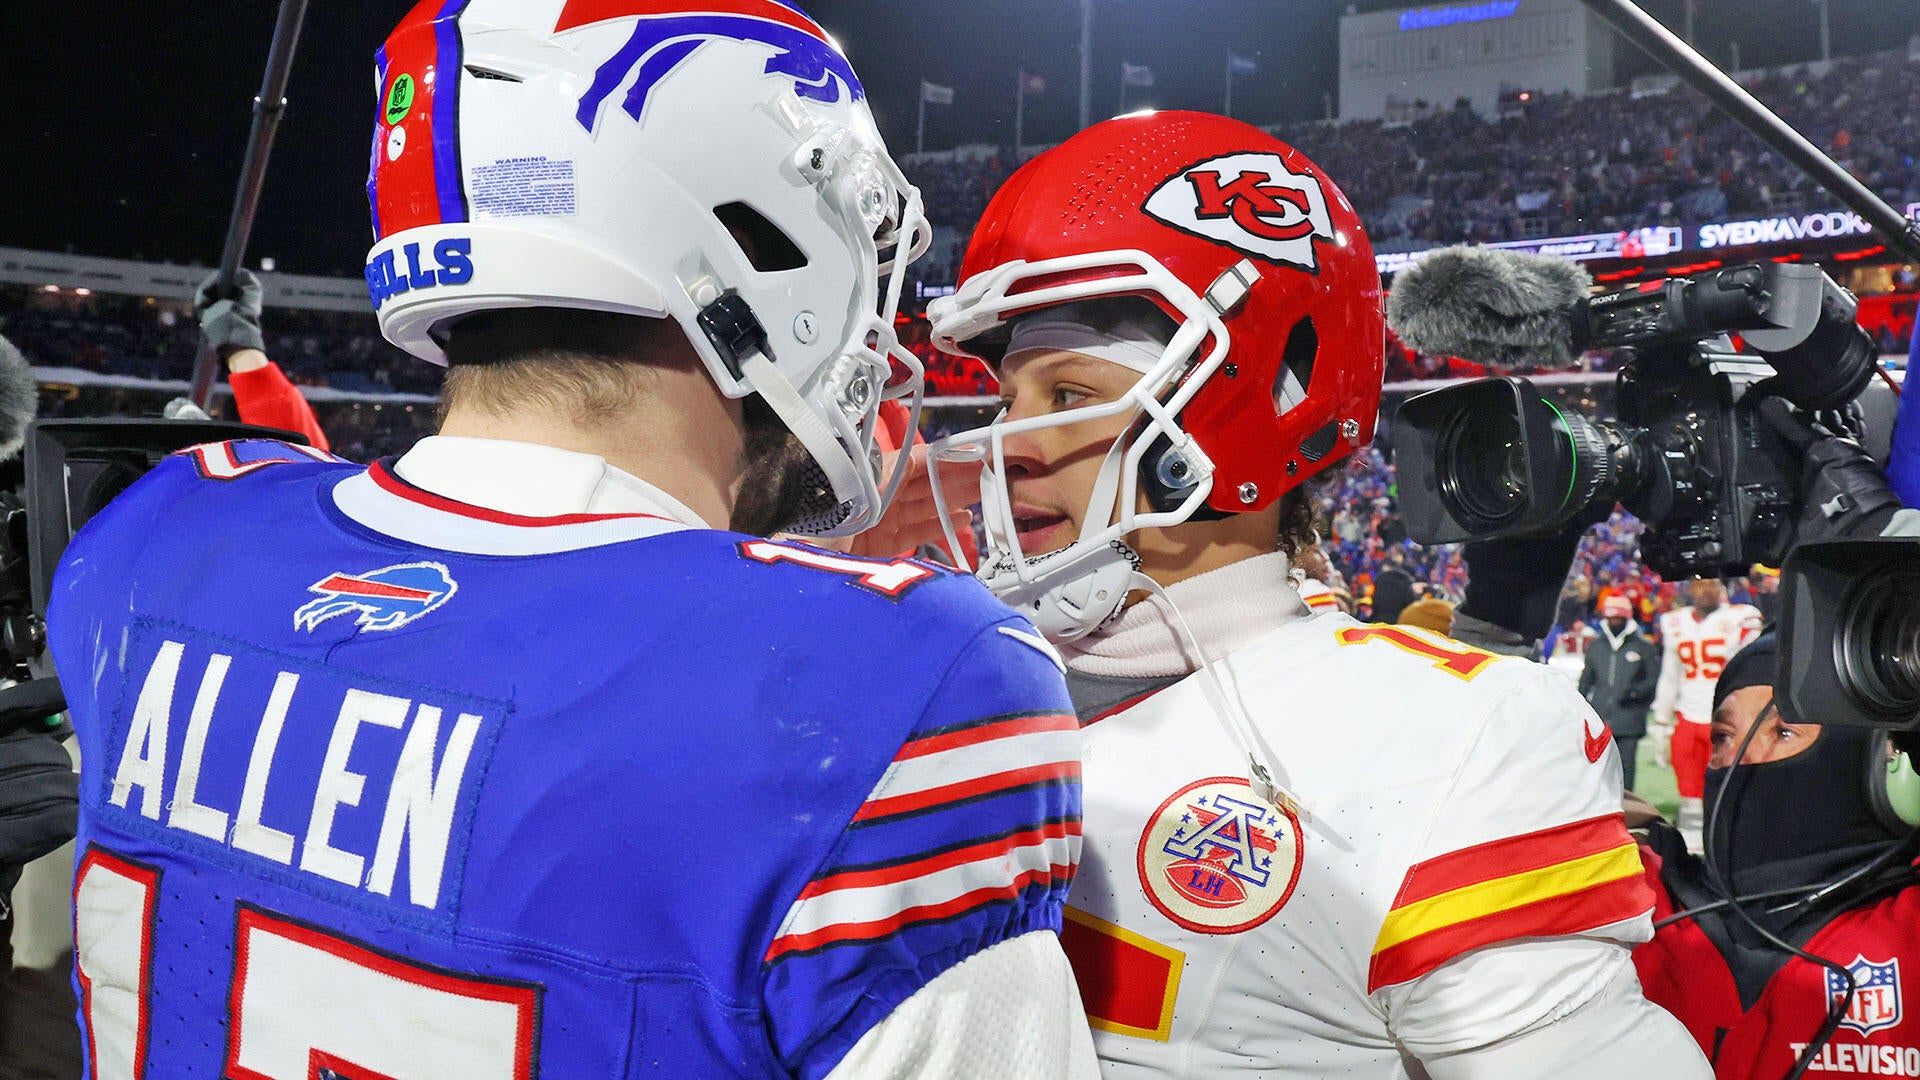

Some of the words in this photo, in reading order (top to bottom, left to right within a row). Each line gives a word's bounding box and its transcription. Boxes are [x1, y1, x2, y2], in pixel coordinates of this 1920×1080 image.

[495, 155, 548, 166] WARNING
[1184, 170, 1316, 242] KC
[1590, 293, 1621, 306] SONY
[1676, 638, 1727, 680] 95
[107, 640, 484, 910] ALLEN
[1188, 869, 1225, 897] LH
